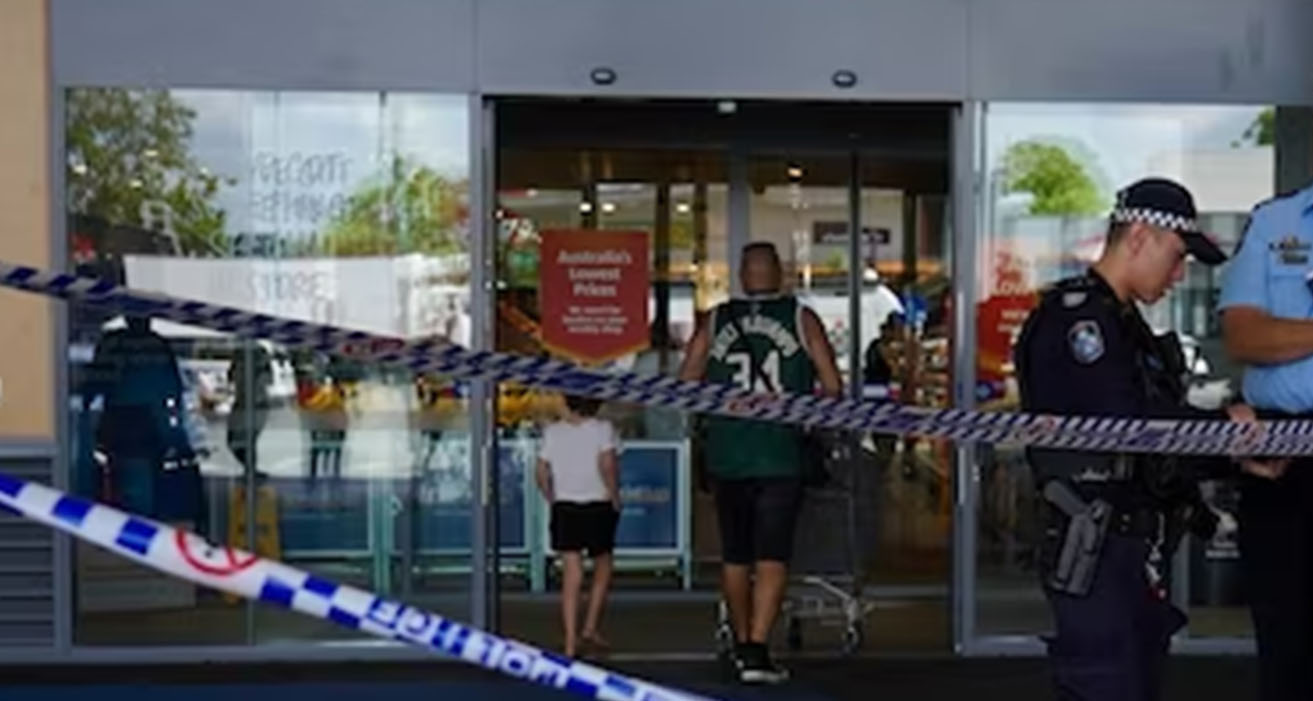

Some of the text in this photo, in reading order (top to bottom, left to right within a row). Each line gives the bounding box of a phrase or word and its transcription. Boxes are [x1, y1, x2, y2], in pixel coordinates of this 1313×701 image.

[557, 250, 632, 264] Australia's
[568, 268, 620, 281] Lowest
[572, 283, 618, 297] Prices
[367, 597, 572, 690] POLICE
